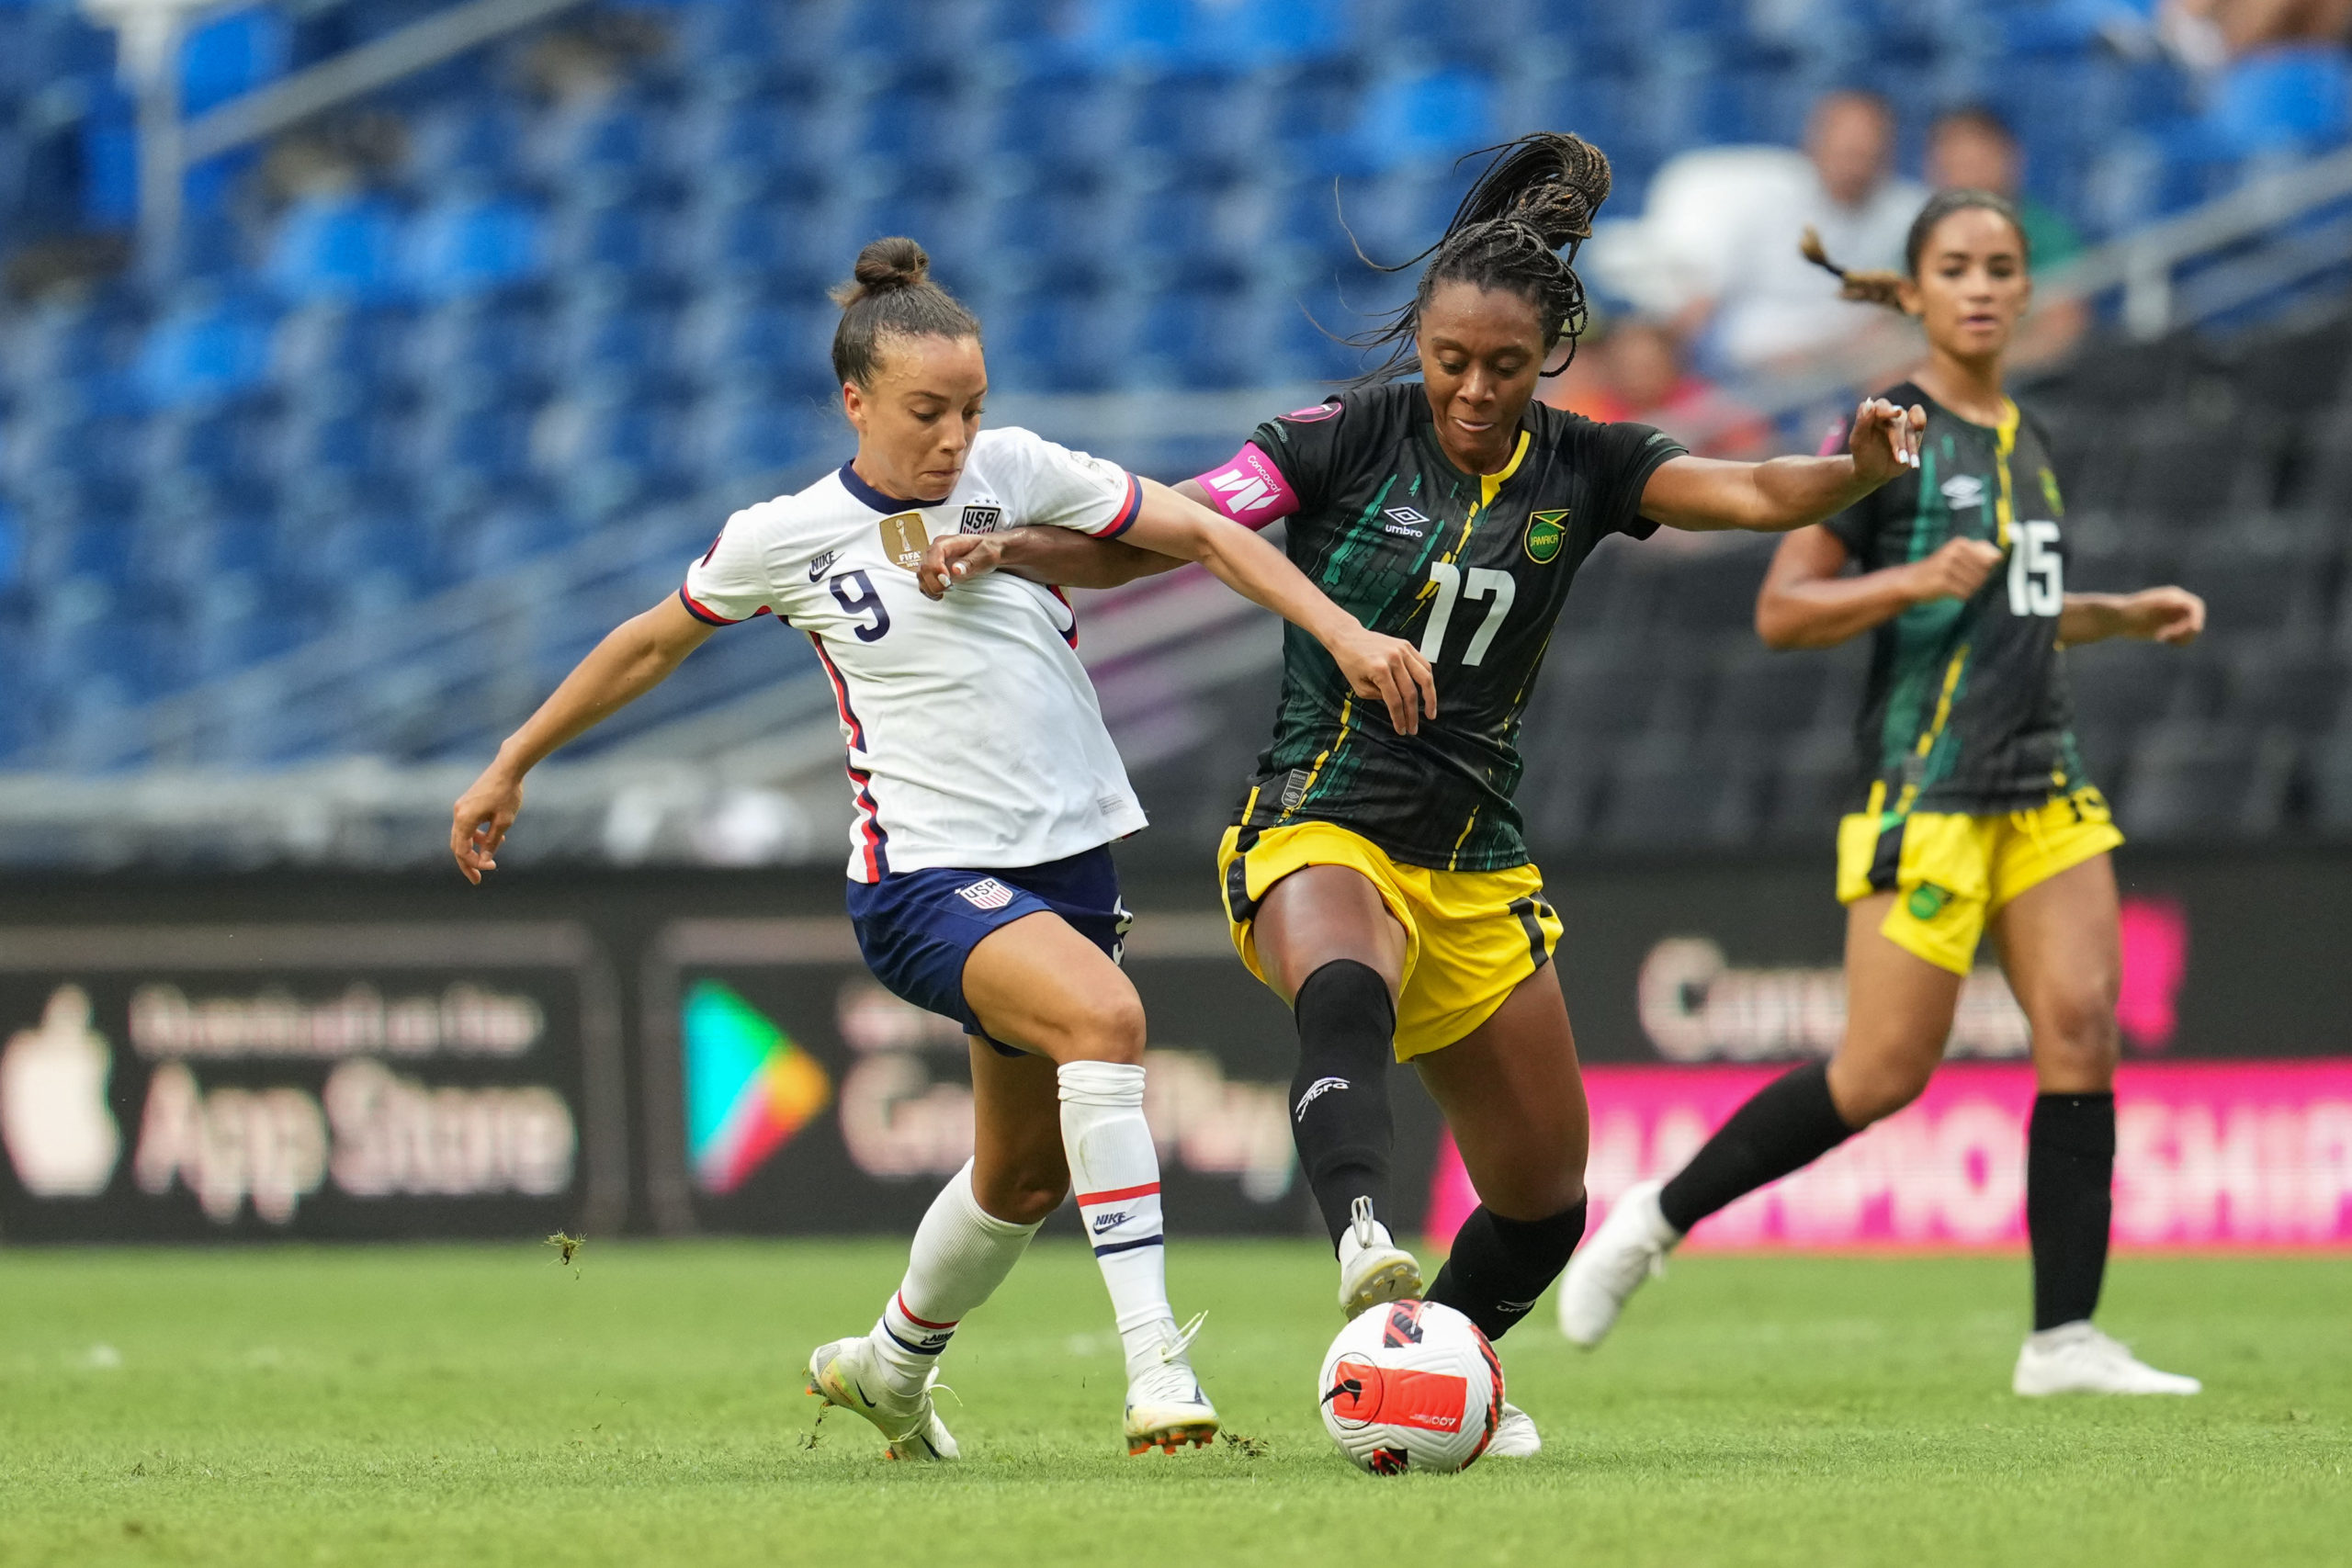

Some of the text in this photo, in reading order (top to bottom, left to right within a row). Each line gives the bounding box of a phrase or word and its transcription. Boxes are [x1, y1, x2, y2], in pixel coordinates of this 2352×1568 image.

[1247, 455, 1282, 493] Concacaf
[965, 509, 994, 529] USA
[1385, 524, 1423, 538] umbro
[1530, 534, 1558, 547] JAMAICA
[810, 550, 835, 572] NIKE
[899, 551, 922, 562] FIFA
[2007, 520, 2064, 616] 15
[829, 570, 891, 643] 9
[1419, 561, 1516, 666] 17
[964, 879, 998, 899] USA
[1095, 1211, 1126, 1225] NIKE
